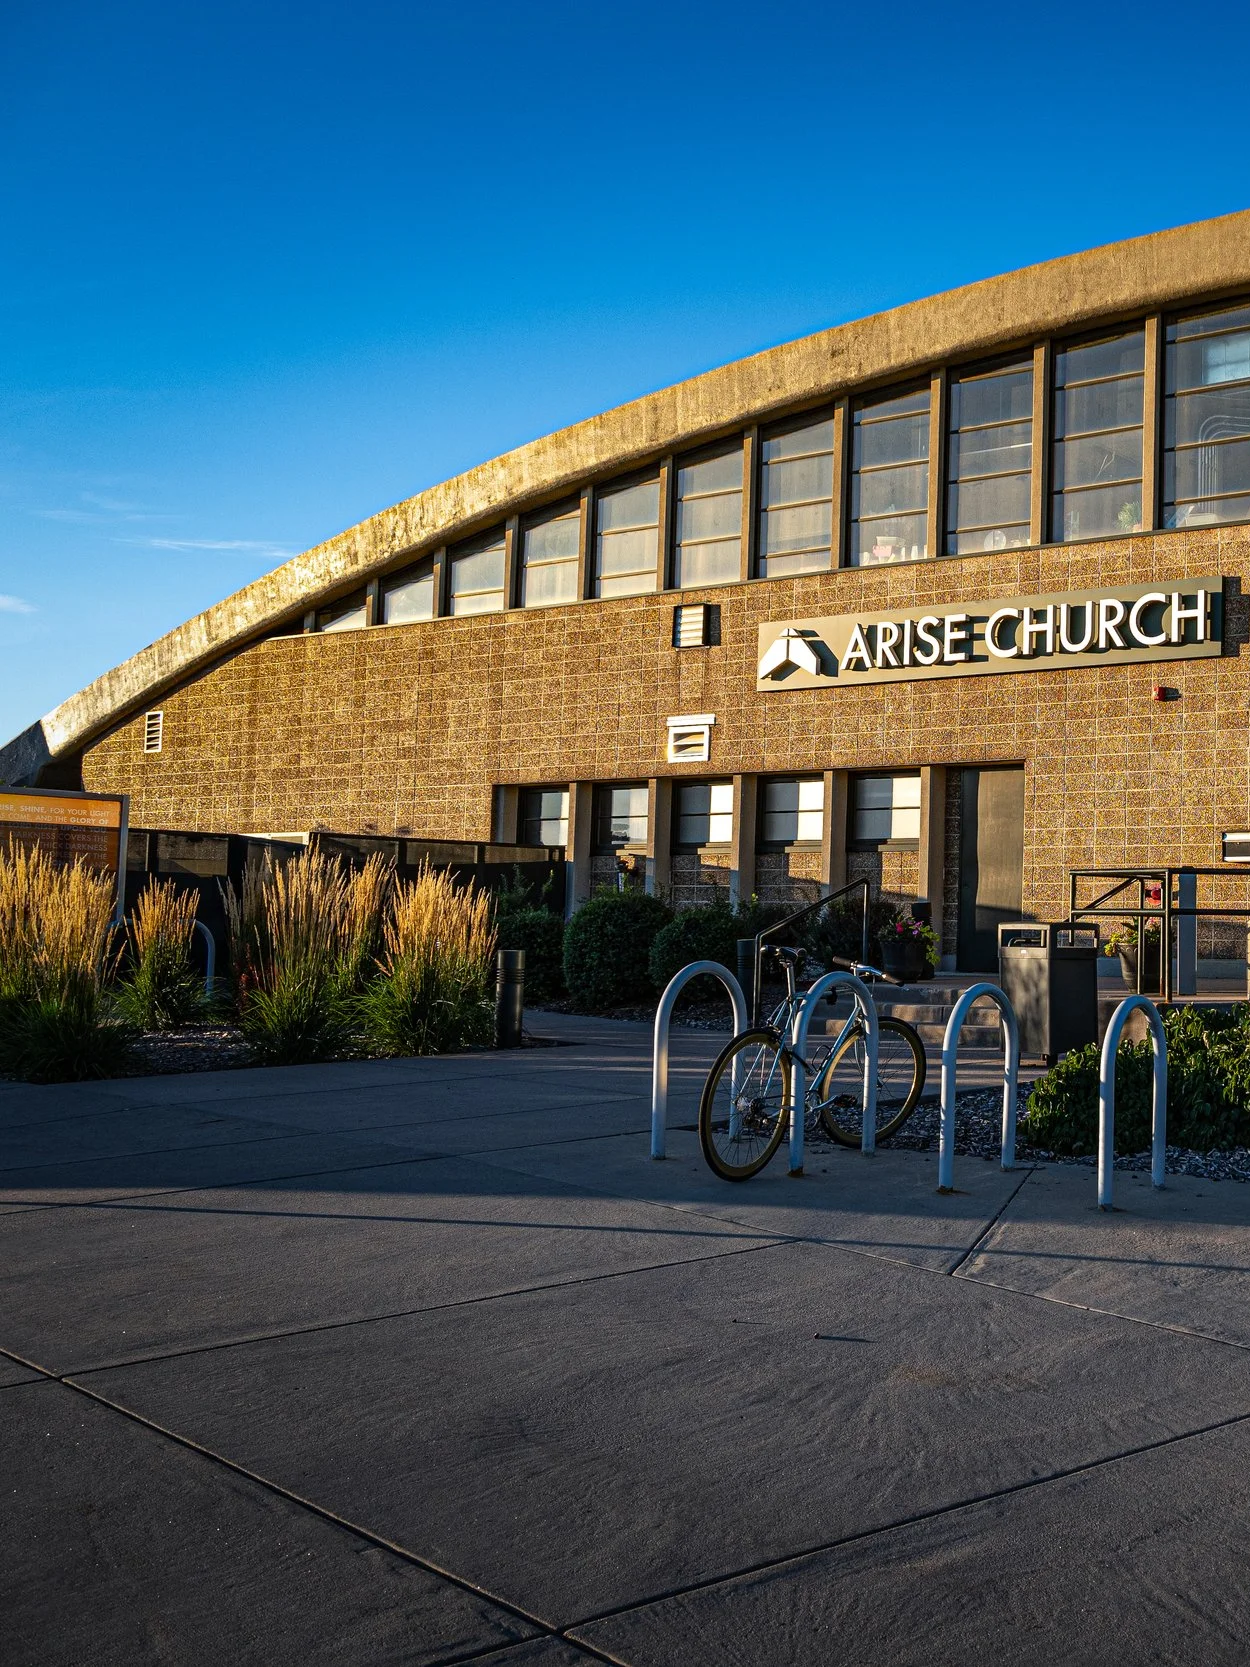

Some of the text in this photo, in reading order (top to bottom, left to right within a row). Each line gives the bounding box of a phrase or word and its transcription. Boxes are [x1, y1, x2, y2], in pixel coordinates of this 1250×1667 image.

[840, 589, 1206, 671] ARISE CHURCH
[67, 808, 88, 816] YOUR
[70, 817, 96, 825] GLORY
[94, 835, 108, 843] THE
